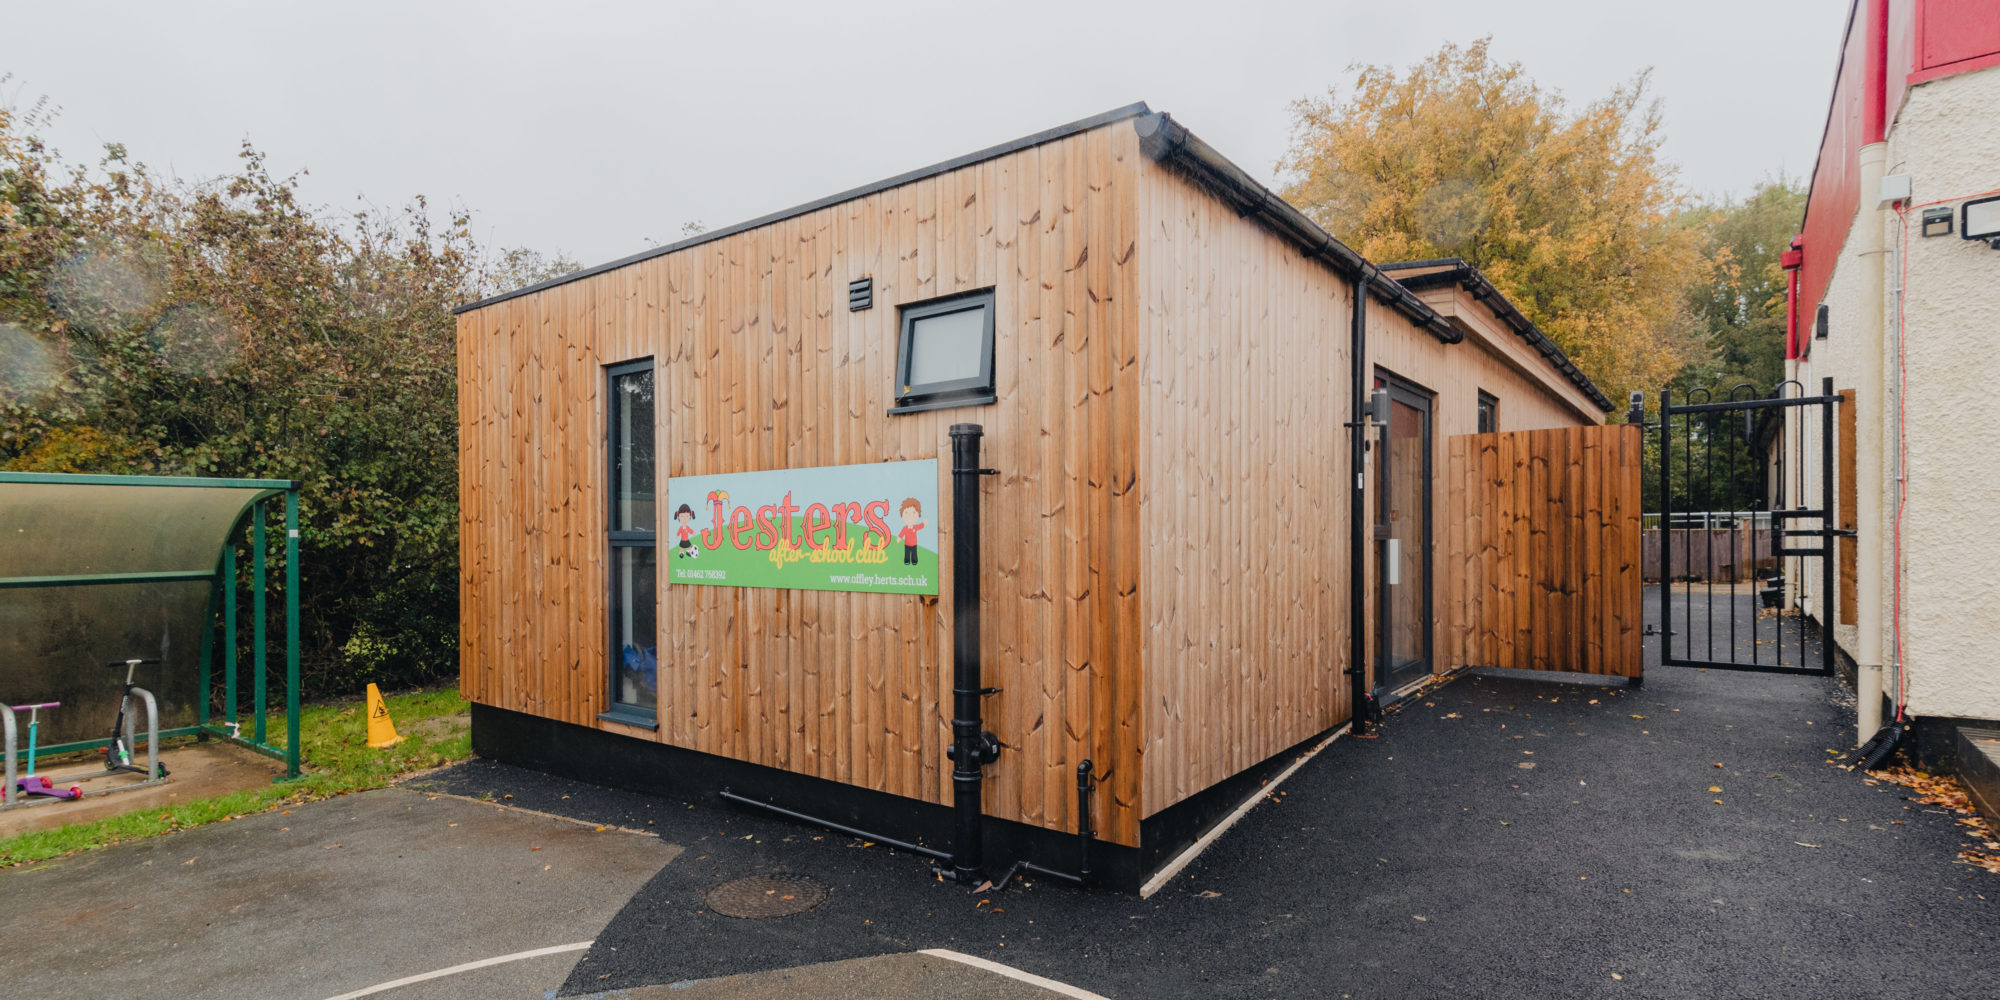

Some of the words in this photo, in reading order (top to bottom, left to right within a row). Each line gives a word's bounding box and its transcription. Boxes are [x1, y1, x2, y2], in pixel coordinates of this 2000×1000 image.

[701, 490, 892, 551] Jesters
[769, 538, 855, 569] after-school
[855, 538, 889, 564] club
[830, 573, 928, 587] www.offley.herts.sch.uk
